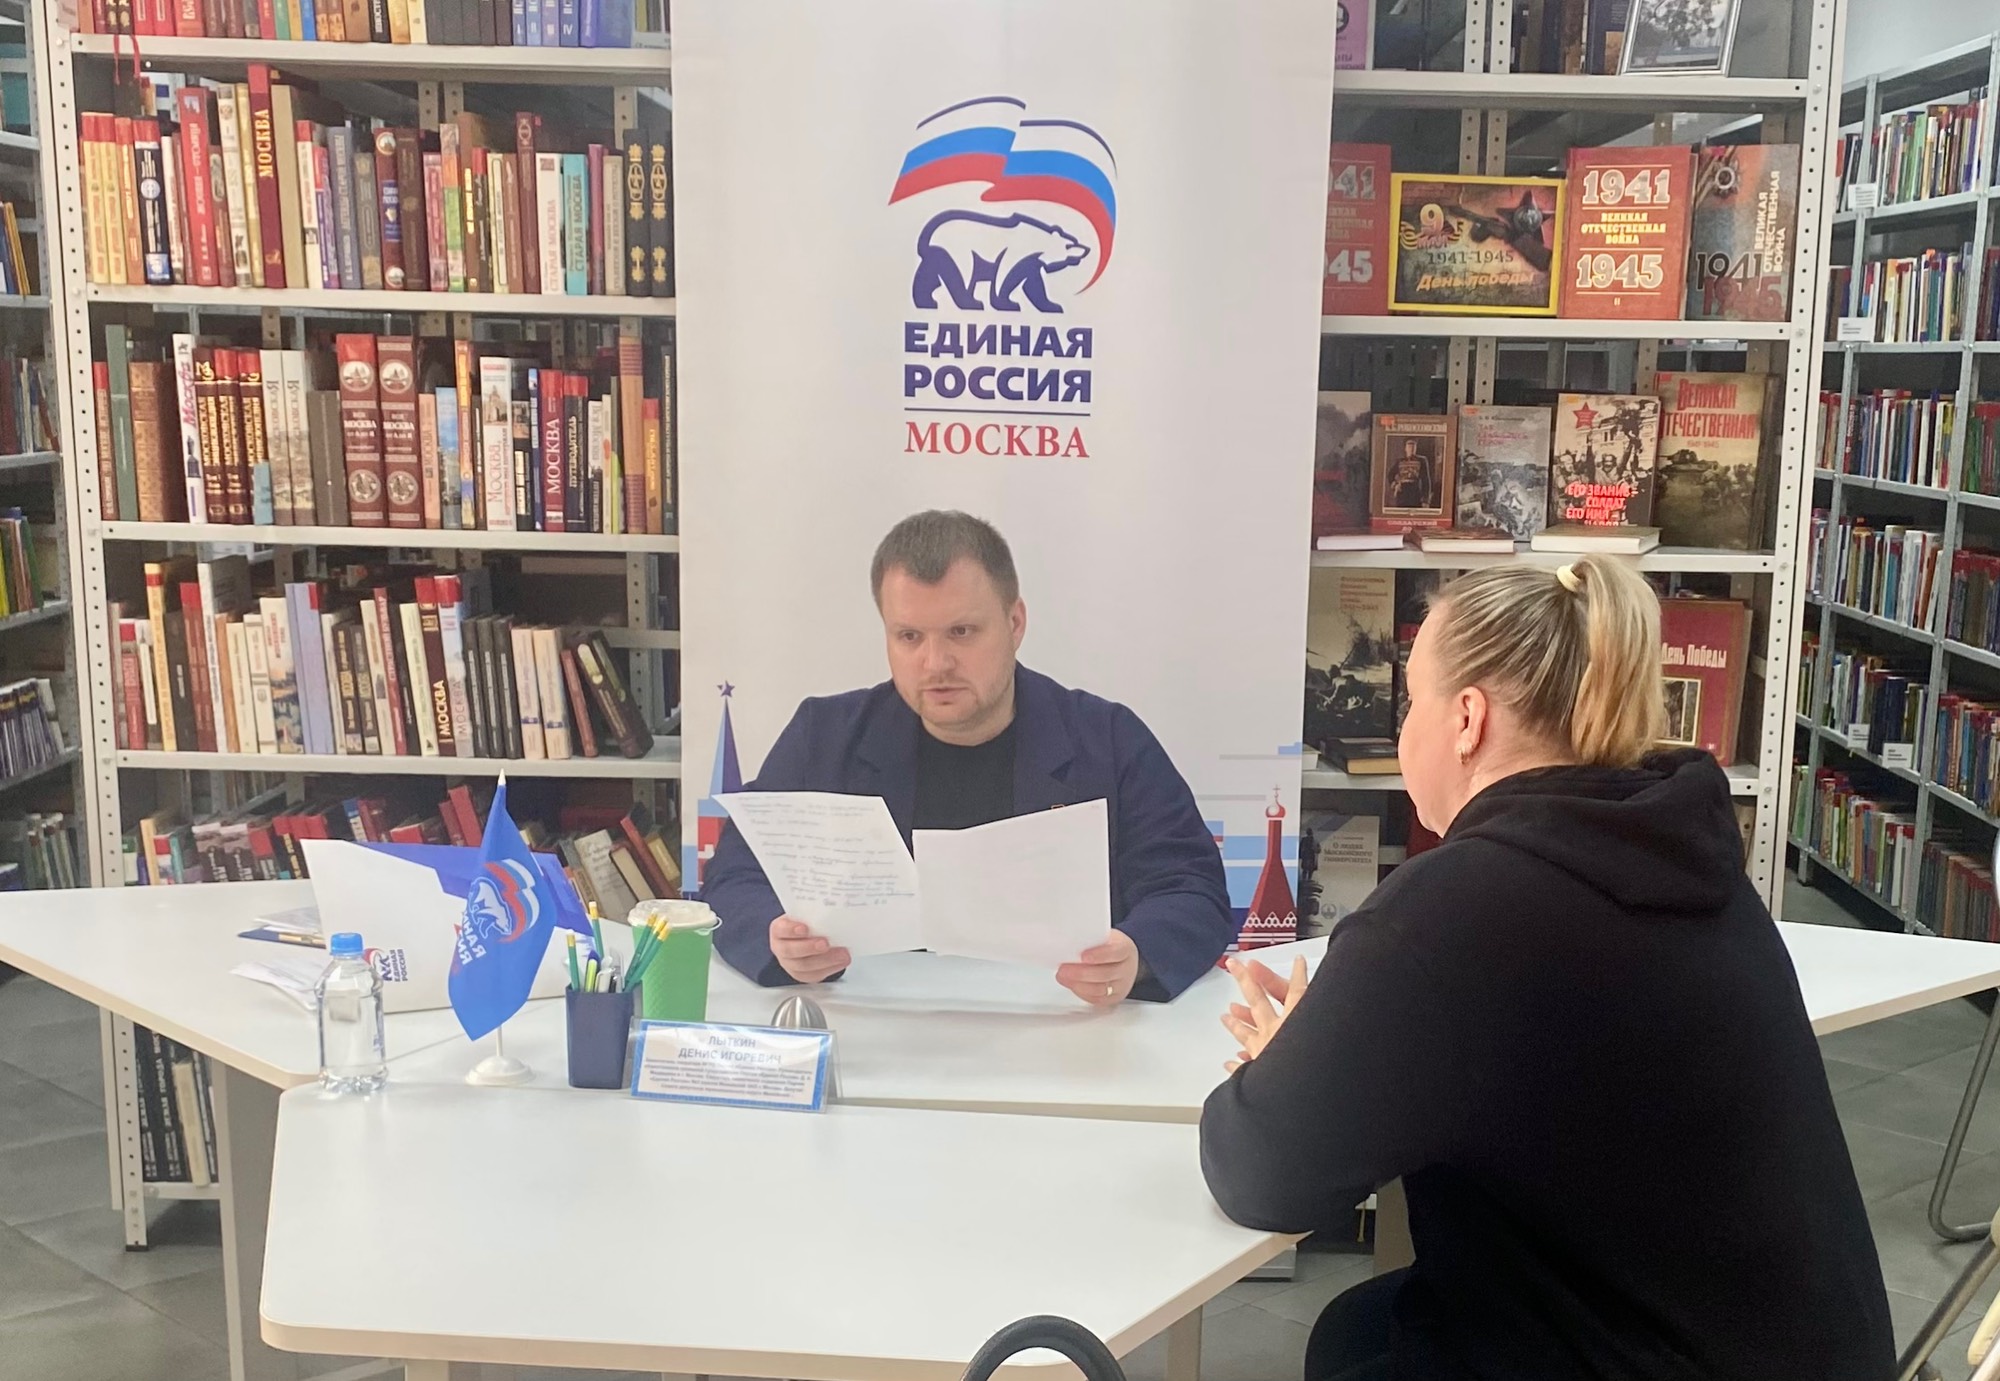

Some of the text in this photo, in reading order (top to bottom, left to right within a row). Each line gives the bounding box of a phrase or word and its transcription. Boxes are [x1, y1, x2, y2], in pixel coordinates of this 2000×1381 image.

[563, 23, 574, 36] IV
[254, 108, 274, 179] МОСКВА
[1582, 169, 1670, 205] 1941
[572, 174, 584, 272] СТАРАЯ МОСКВА
[1420, 203, 1444, 234] 9
[1581, 223, 1666, 234] ОТЕЧЕСТВЕННАЯ
[1600, 212, 1648, 222] ВЕЛИКАЯ
[1754, 192, 1768, 250] ВЕЛИКАЯ
[1763, 170, 1780, 273] ОТЕЧЕСТВЕННАЯ
[546, 199, 559, 291] СТАРАЯ МОСКВА
[1605, 232, 1639, 244] ВОЙНА
[1773, 227, 1786, 273] ВОЙНА
[1427, 250, 1514, 264] 1941-1945
[1576, 253, 1663, 288] 1945
[1696, 252, 1763, 292] 1941
[1416, 272, 1463, 292] День
[904, 321, 1093, 359] ЕДИНАЯ
[904, 363, 1092, 403] РОССИЯ
[198, 397, 210, 467] МОСКОВСКАЯ
[219, 396, 232, 467] МОСКОВСКАЯ
[343, 419, 377, 429] МОСКВА
[383, 421, 415, 430] МОСКВА
[904, 421, 1090, 458] МОСКВА
[1664, 412, 1758, 439] ТЕЧЕСТВЕННАЯ
[545, 418, 561, 494] МОСКВА
[568, 415, 578, 488] ПУТЕВОДИТЕЛЬ
[1566, 508, 1584, 519] ЕГО
[1660, 642, 1727, 668] День Победы
[433, 680, 452, 737] МОСКВА
[452, 680, 466, 737] МОСКВА
[389, 949, 401, 982] ЕДИНАЯ
[397, 949, 408, 982] РОССИЯ
[678, 1047, 781, 1064] ДЕНИС ИГОРЕВИЧ
[155, 1058, 167, 1093] ГОРОДА
